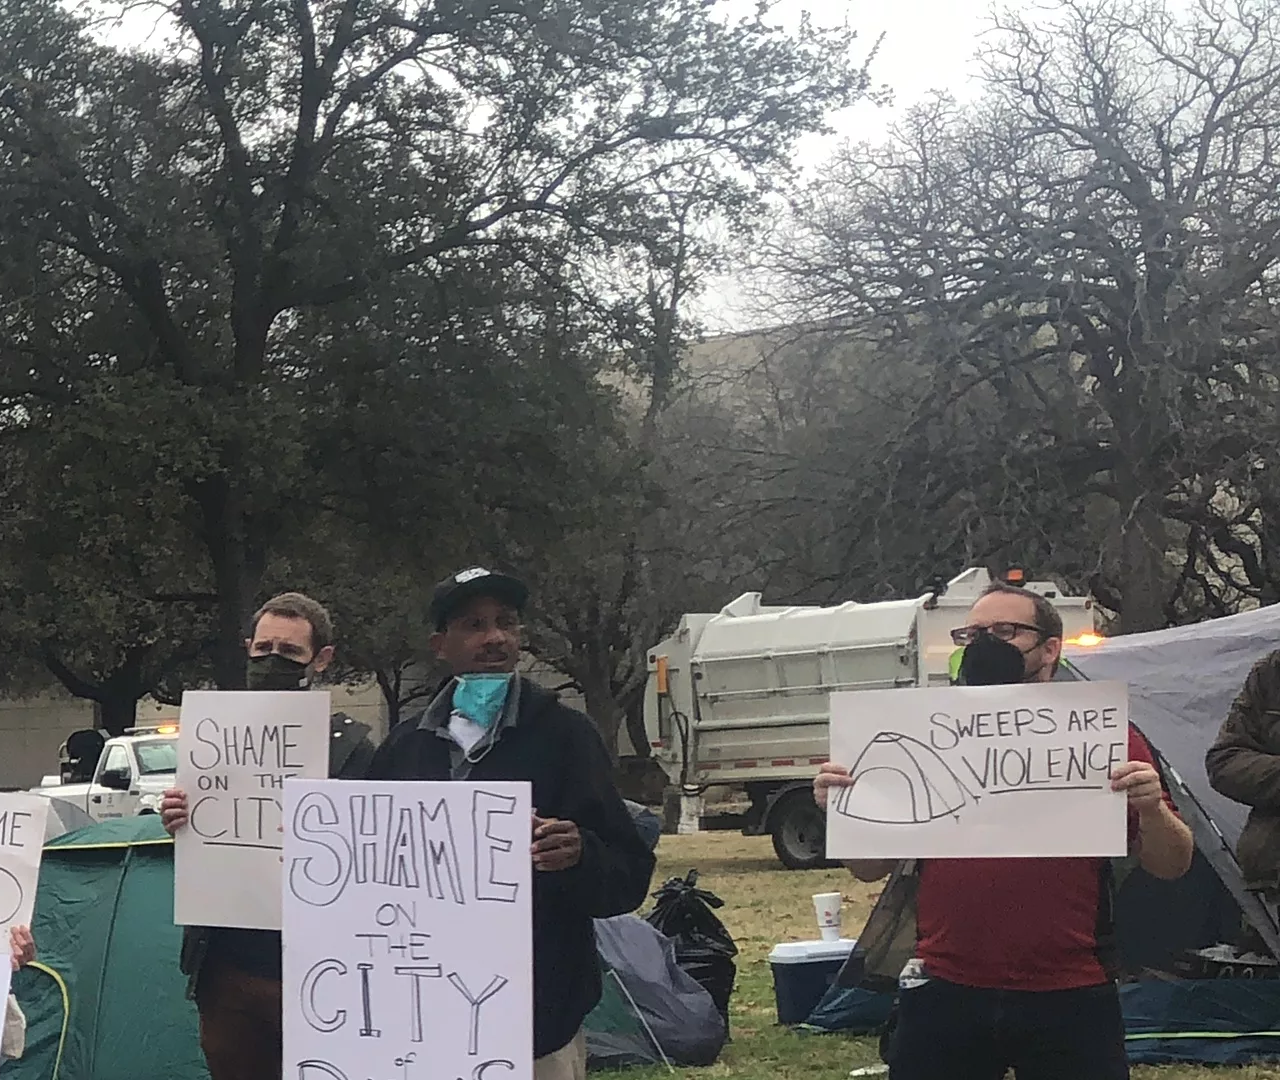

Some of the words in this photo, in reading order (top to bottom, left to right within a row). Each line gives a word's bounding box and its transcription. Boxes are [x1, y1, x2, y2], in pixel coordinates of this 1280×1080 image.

[190, 717, 304, 770] SHAME
[929, 708, 1057, 750] SWEEPS
[1068, 708, 1118, 733] ARE
[197, 775, 228, 791] ON
[253, 773, 298, 789] TH
[961, 743, 1125, 789] VIOLENCE
[191, 796, 283, 839] CIT
[289, 790, 519, 906] SHAME
[376, 901, 416, 928] ON
[355, 932, 431, 960] THE
[300, 958, 509, 1056] CITY
